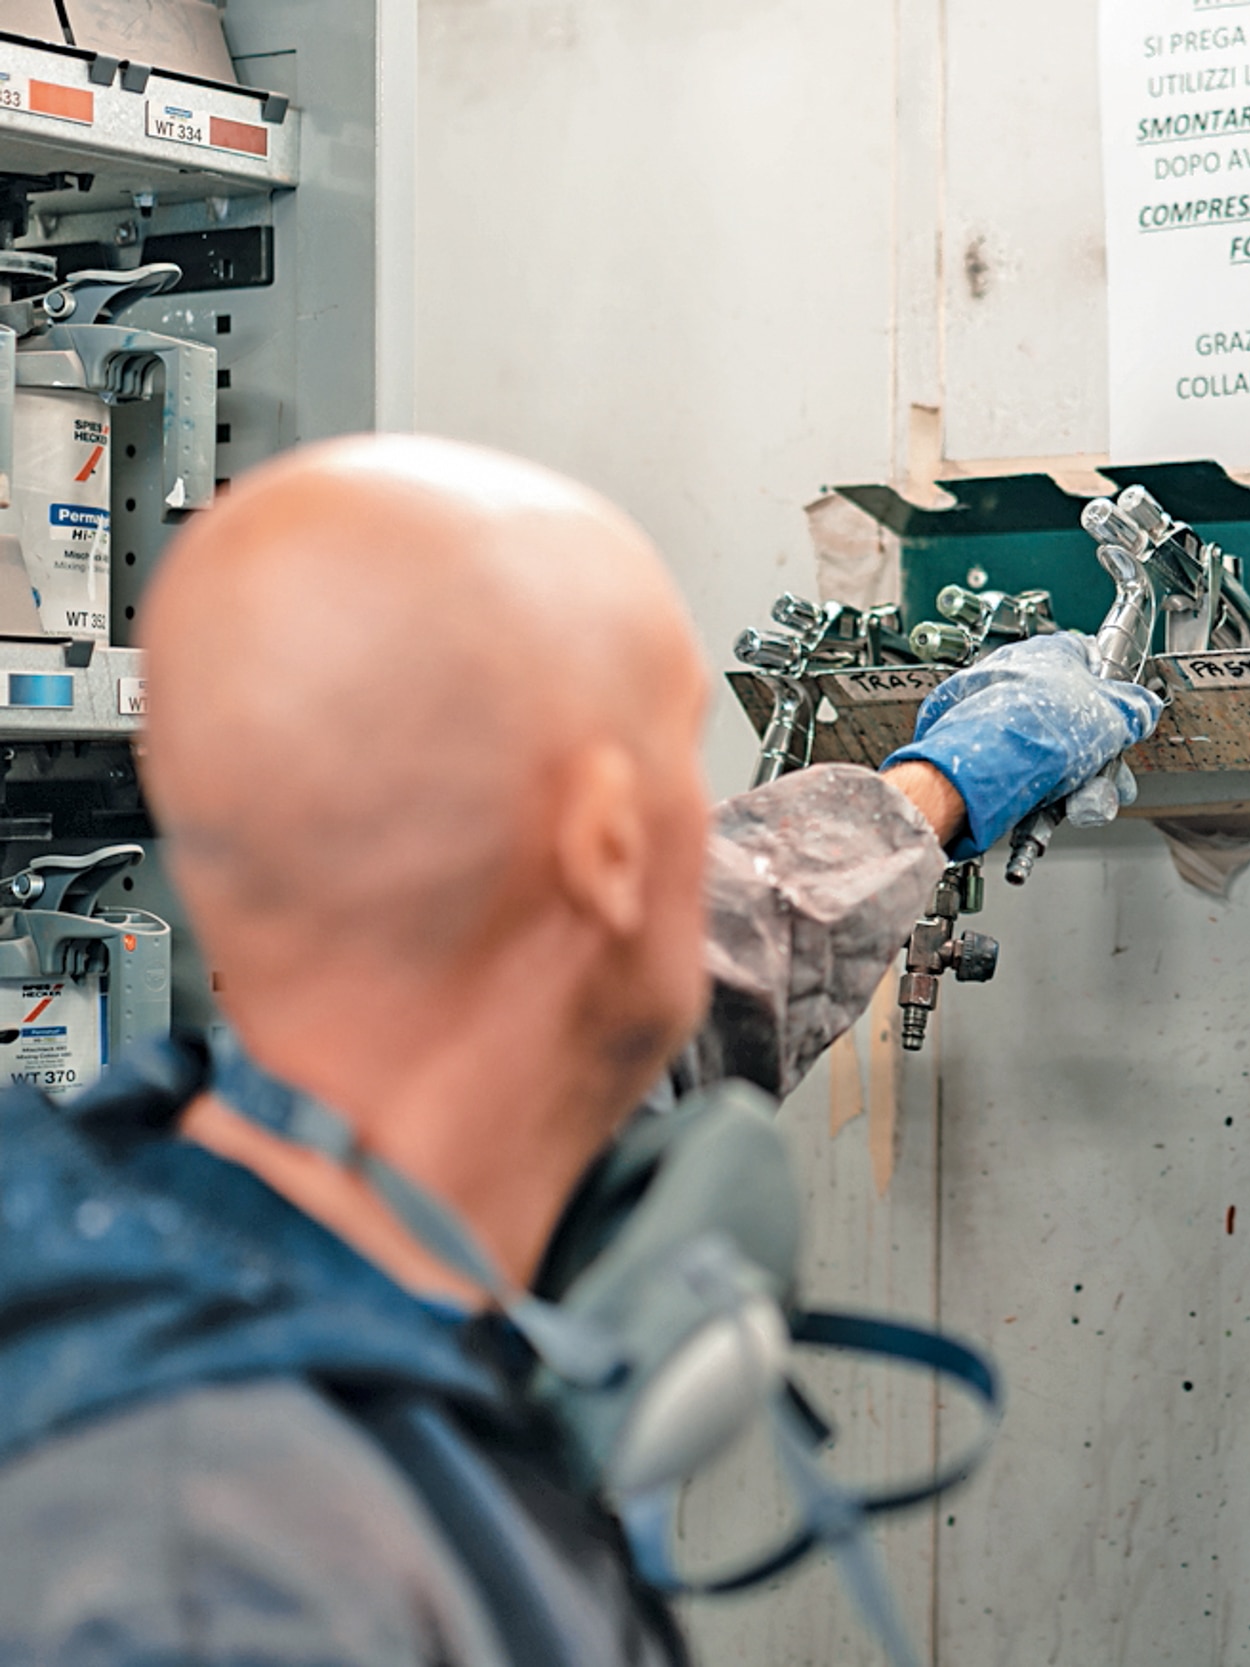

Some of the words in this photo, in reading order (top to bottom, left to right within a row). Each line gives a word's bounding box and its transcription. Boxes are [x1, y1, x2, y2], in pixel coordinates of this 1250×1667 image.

[1144, 37, 1162, 58] SI
[1171, 26, 1246, 53] PREGA
[1149, 67, 1235, 98] UTILIZZI
[0, 89, 21, 107] 33
[155, 119, 174, 137] WT
[177, 125, 202, 142] 334
[1155, 152, 1220, 179] DOPO
[66, 611, 88, 627] WT
[11, 1072, 41, 1085] WT
[45, 1069, 76, 1084] 370
